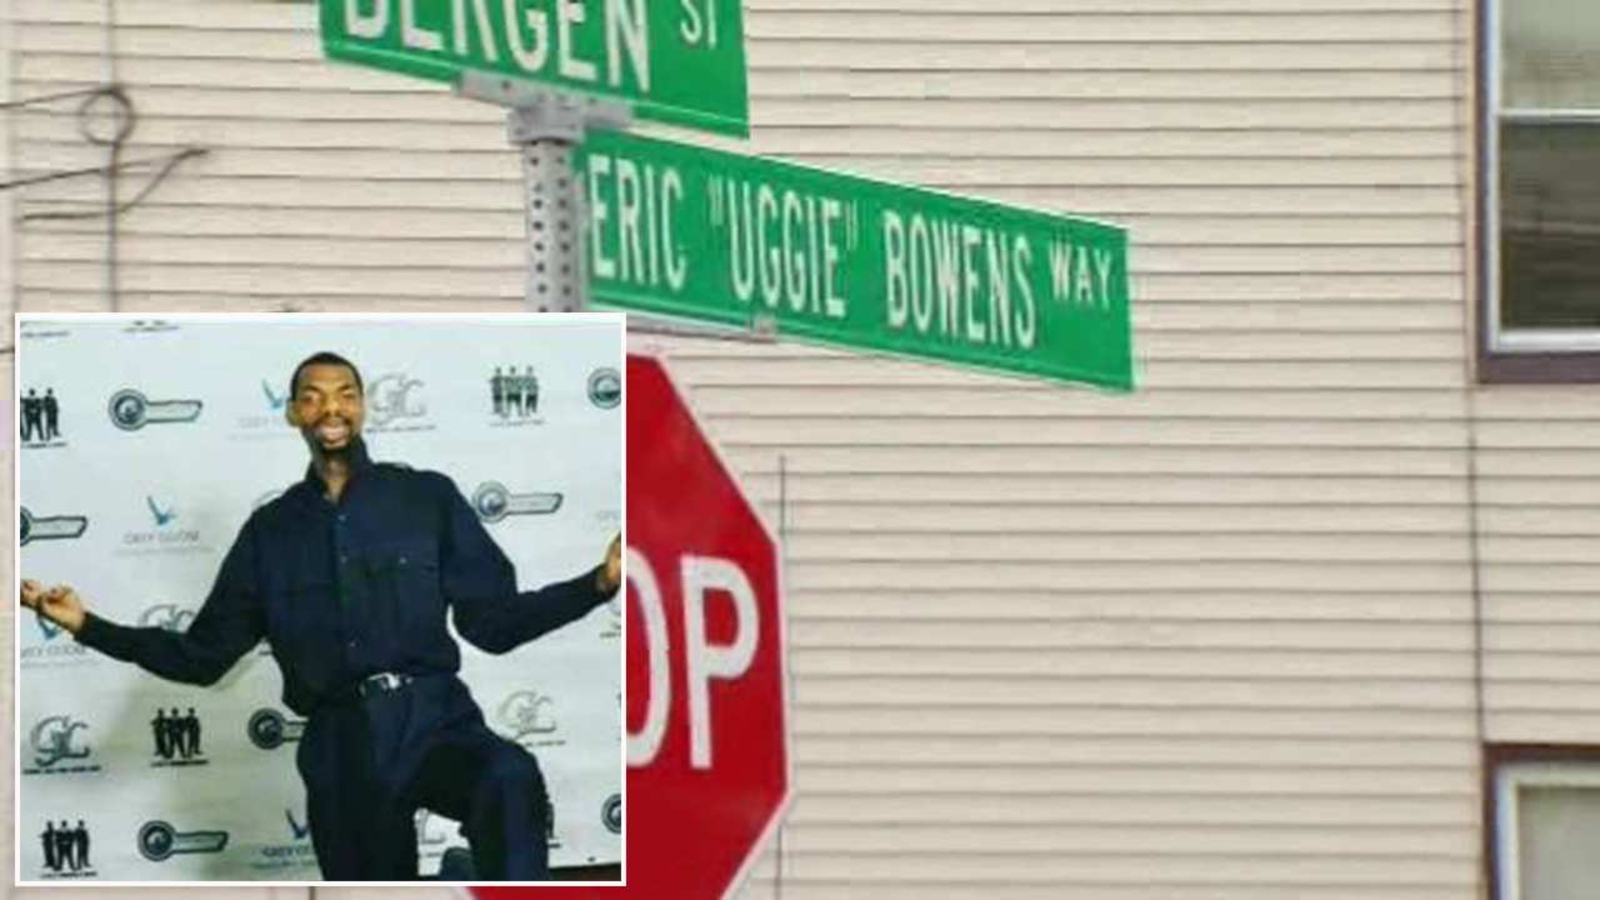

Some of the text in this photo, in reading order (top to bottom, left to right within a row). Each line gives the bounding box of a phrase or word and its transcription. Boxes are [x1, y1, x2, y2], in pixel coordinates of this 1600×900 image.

[588, 153, 1112, 349] ERIC "UGGIE" BOWENS WAY
